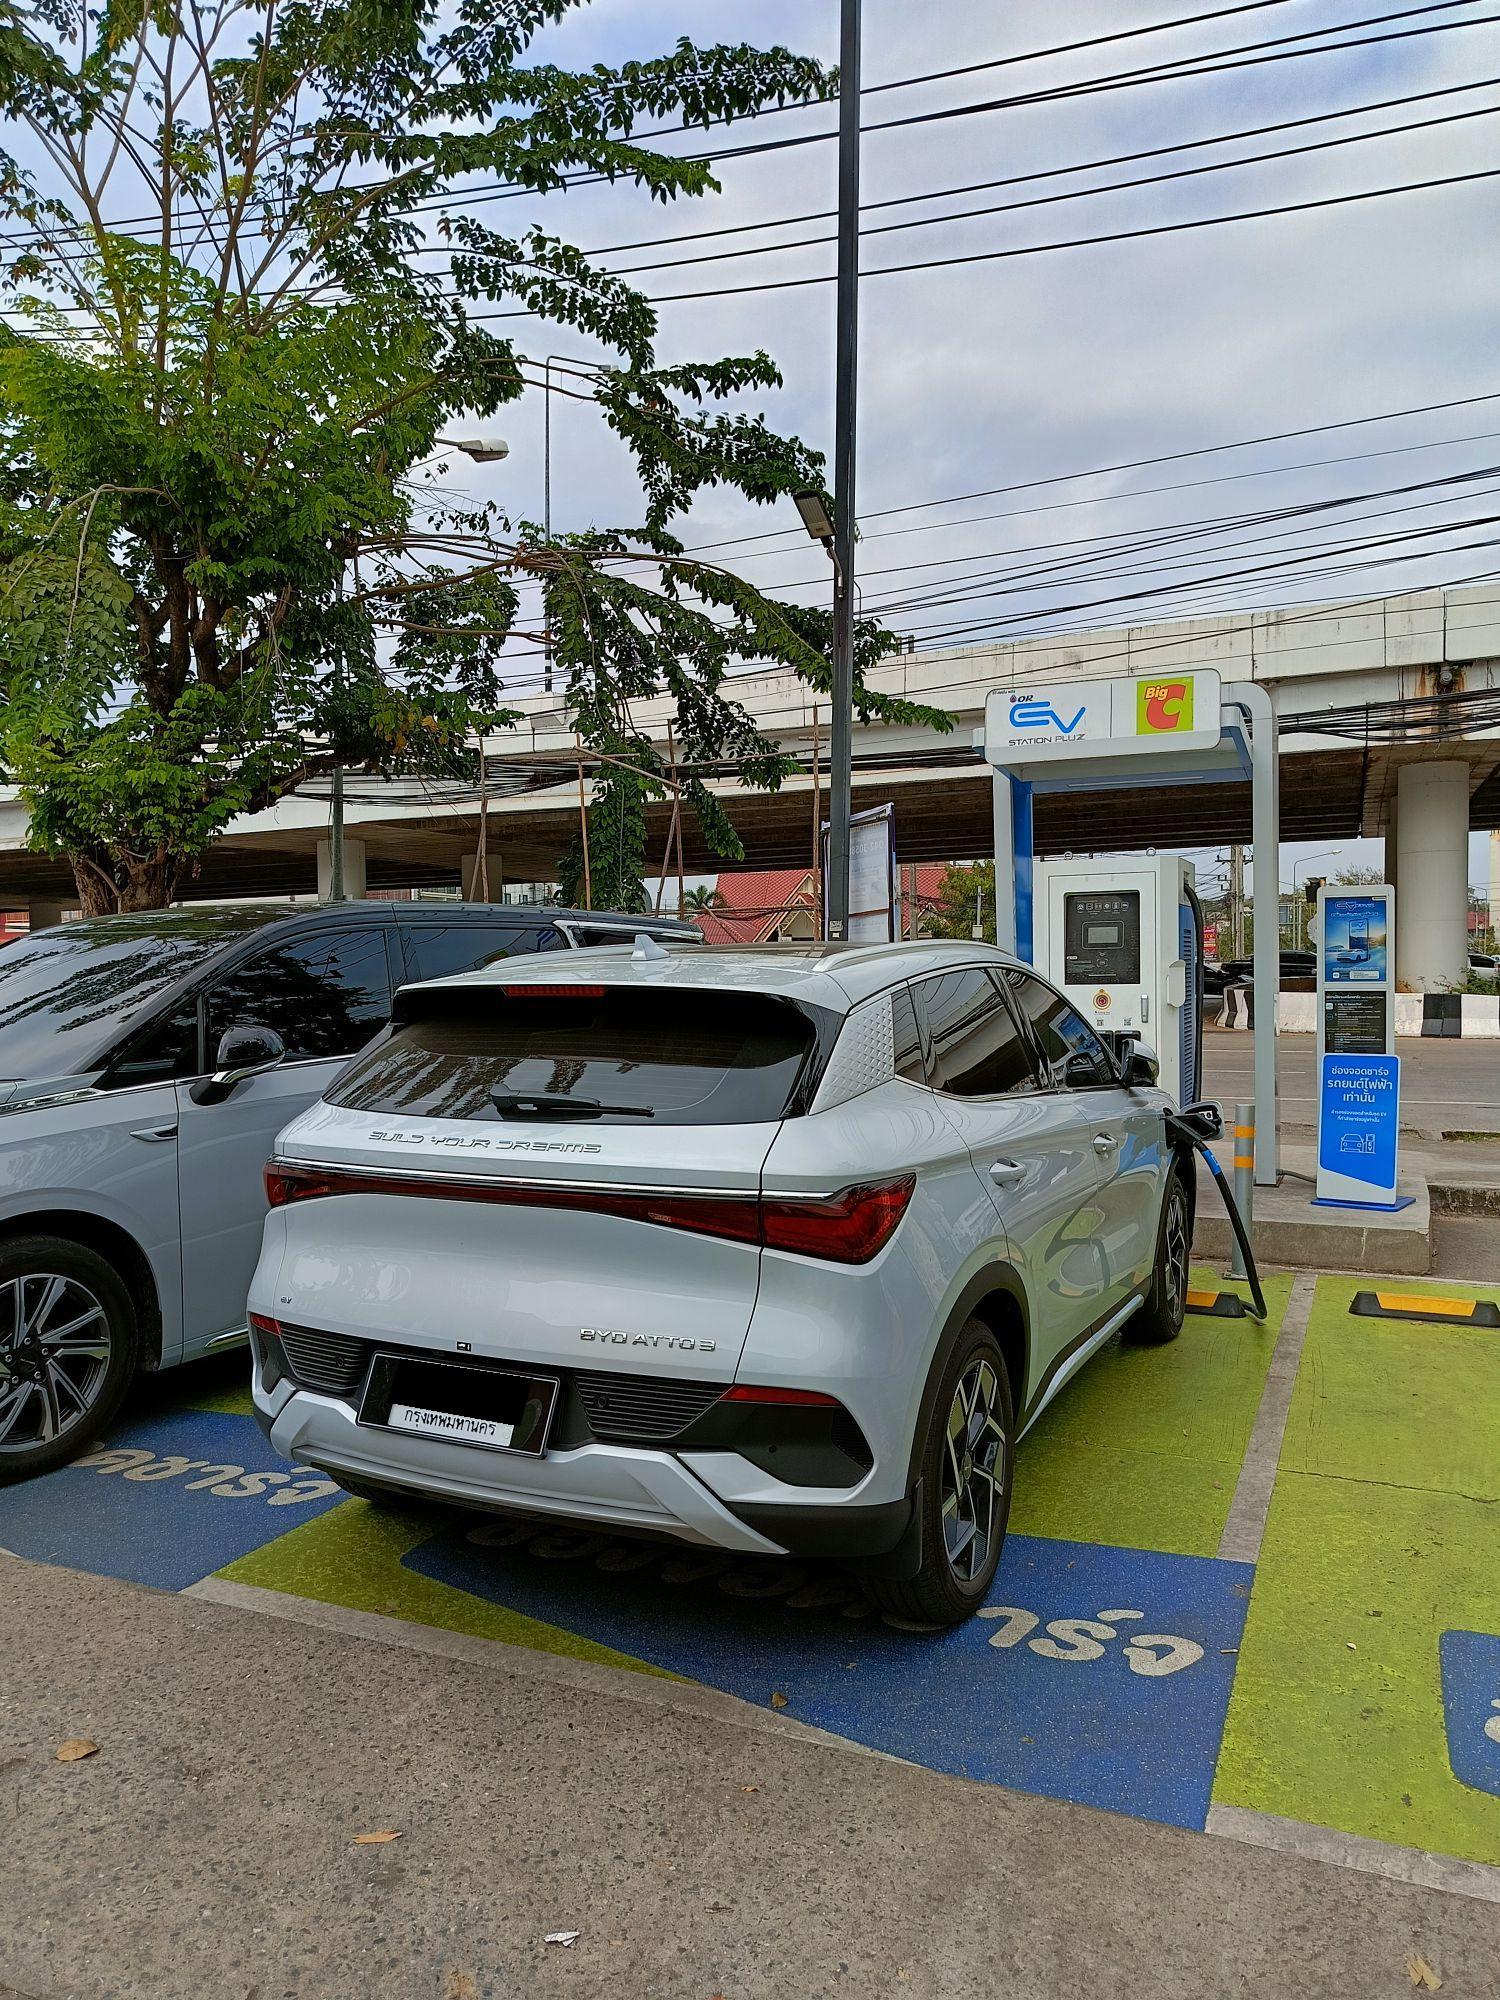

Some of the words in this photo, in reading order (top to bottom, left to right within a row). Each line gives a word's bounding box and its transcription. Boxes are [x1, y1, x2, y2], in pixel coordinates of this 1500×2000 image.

[1017, 694, 1034, 703] OR
[1144, 686, 1168, 700] Big
[1146, 684, 1186, 730] C
[1009, 701, 1086, 734] EV
[1008, 736, 1052, 747] STATION
[1055, 733, 1086, 743] PLUZ
[1331, 1065, 1389, 1076] ช่องจอดชาร์จ
[1327, 1078, 1393, 1090] รถยนต์ไฟฟ้า
[1343, 1089, 1376, 1103] เท่านั้น
[368, 1130, 424, 1144] BUILD
[431, 1134, 490, 1149] YOUR
[496, 1140, 602, 1154] DREAMS
[580, 1328, 628, 1345] BYD
[632, 1334, 696, 1351] ATTO
[699, 1339, 717, 1352] 3
[404, 1409, 497, 1437] กรุงเทพมหานคร
